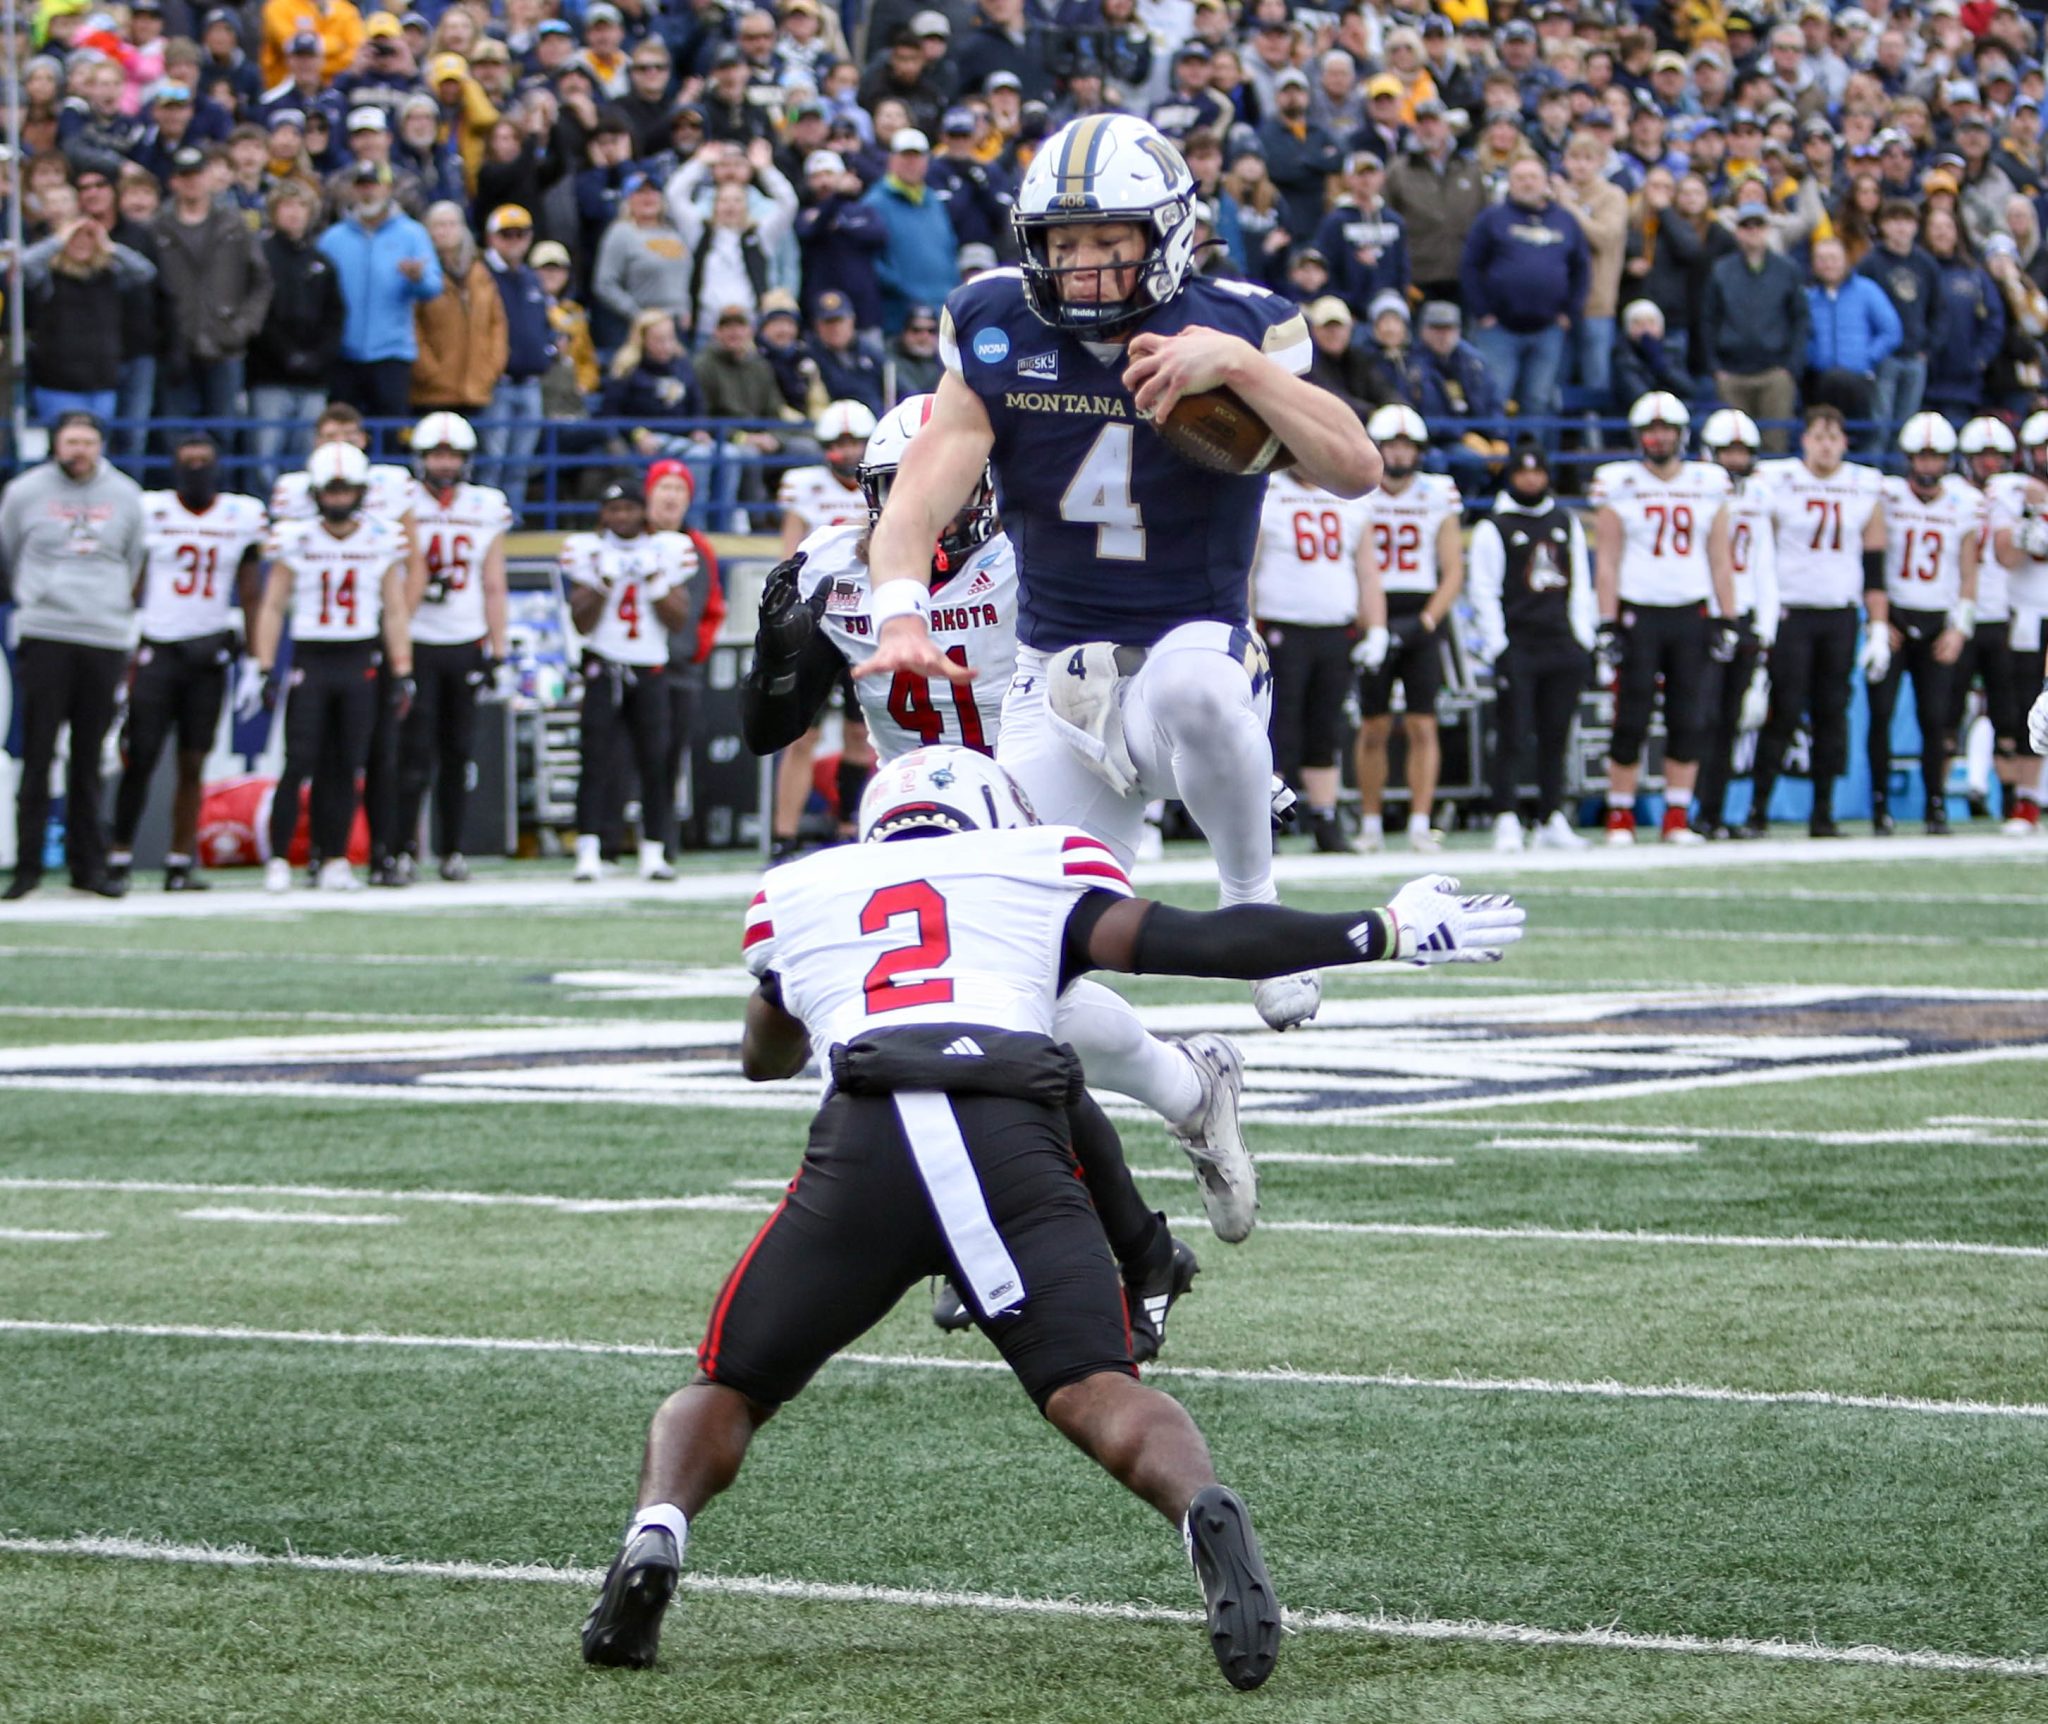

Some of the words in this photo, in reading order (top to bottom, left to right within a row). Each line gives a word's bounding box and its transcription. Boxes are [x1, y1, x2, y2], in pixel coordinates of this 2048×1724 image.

[1059, 194, 1086, 208] 406
[1071, 308, 1102, 317] Riddel
[979, 343, 1007, 355] NCAA
[1034, 353, 1056, 369] SKY
[1006, 392, 1126, 417] MONTANA
[1059, 421, 1147, 561] 4
[1293, 511, 1342, 562] 68
[1645, 504, 1692, 556] 78
[1806, 499, 1842, 549] 71
[174, 545, 216, 597] 31
[427, 534, 471, 590] 46
[1900, 528, 1943, 580] 13
[319, 568, 358, 626] 14
[618, 583, 639, 638] 4
[931, 603, 999, 632] AKOTA
[1067, 648, 1087, 680] 4
[886, 645, 995, 760] 41
[859, 878, 955, 1016] 2
